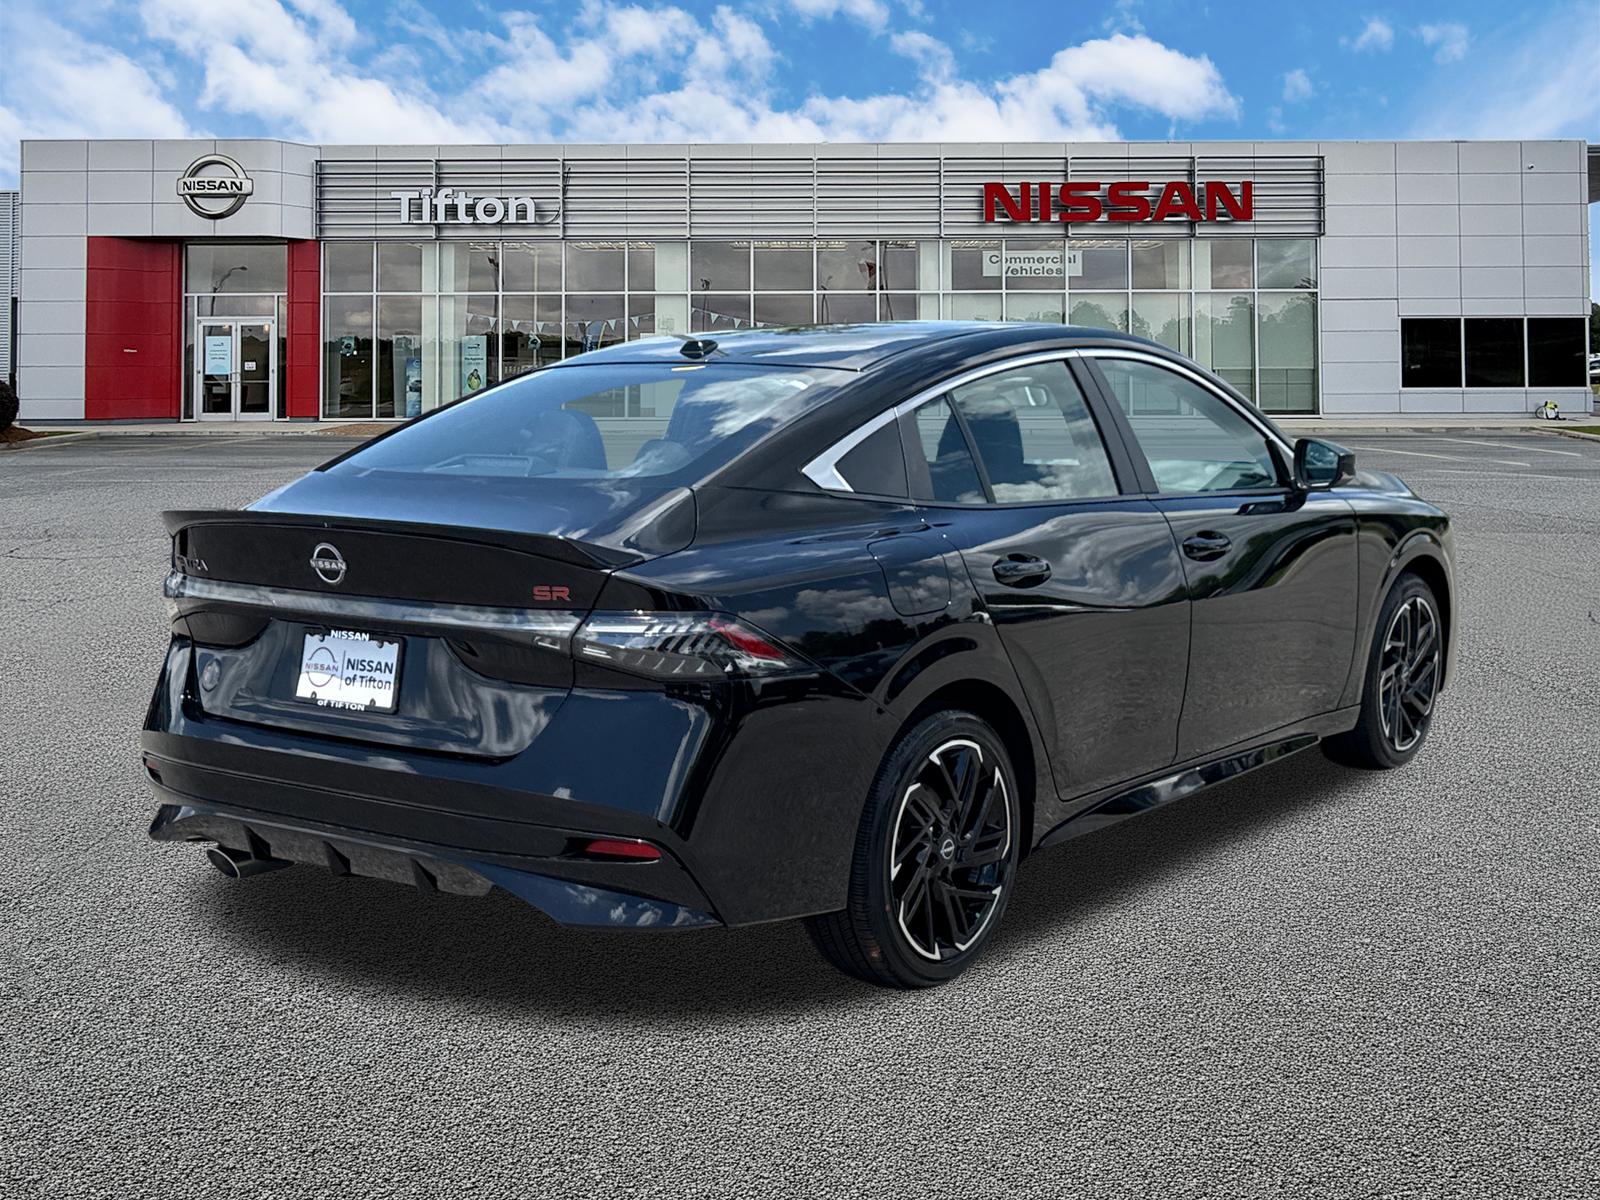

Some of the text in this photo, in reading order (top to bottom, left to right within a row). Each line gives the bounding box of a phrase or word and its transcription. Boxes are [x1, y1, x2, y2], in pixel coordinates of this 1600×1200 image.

[182, 180, 243, 191] NISSAN
[391, 187, 536, 224] Tifton
[983, 180, 1253, 222] NISSAN
[310, 560, 347, 570] NISSAN
[532, 585, 571, 601] SR
[330, 629, 370, 641] NISSAN
[304, 662, 339, 673] NISSAN
[346, 658, 394, 675] NISSAN
[344, 674, 392, 691] of Tifton
[317, 699, 366, 712] of TIFTON
